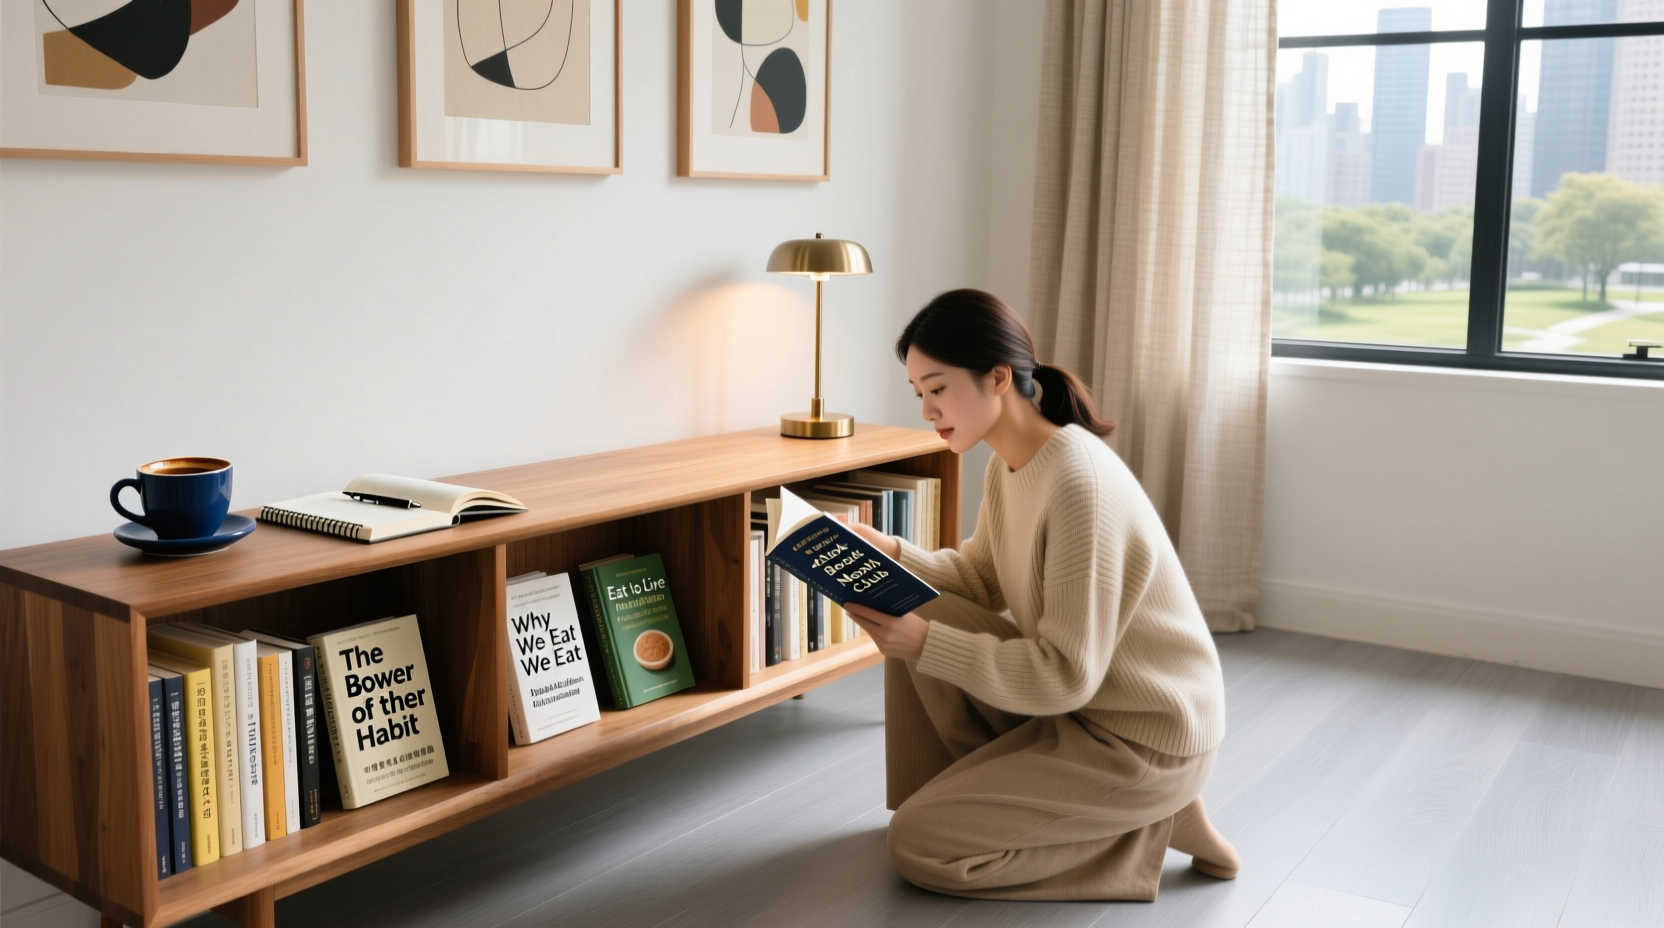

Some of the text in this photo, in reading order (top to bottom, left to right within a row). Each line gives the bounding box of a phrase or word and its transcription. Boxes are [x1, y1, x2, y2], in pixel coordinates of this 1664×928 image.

[511, 611, 551, 634] Why
[516, 624, 576, 656] We Eat
[339, 646, 384, 671] The
[520, 644, 582, 676] We Eat
[344, 664, 414, 698] Bower
[352, 688, 426, 724] of ther
[356, 714, 420, 752] Habit
